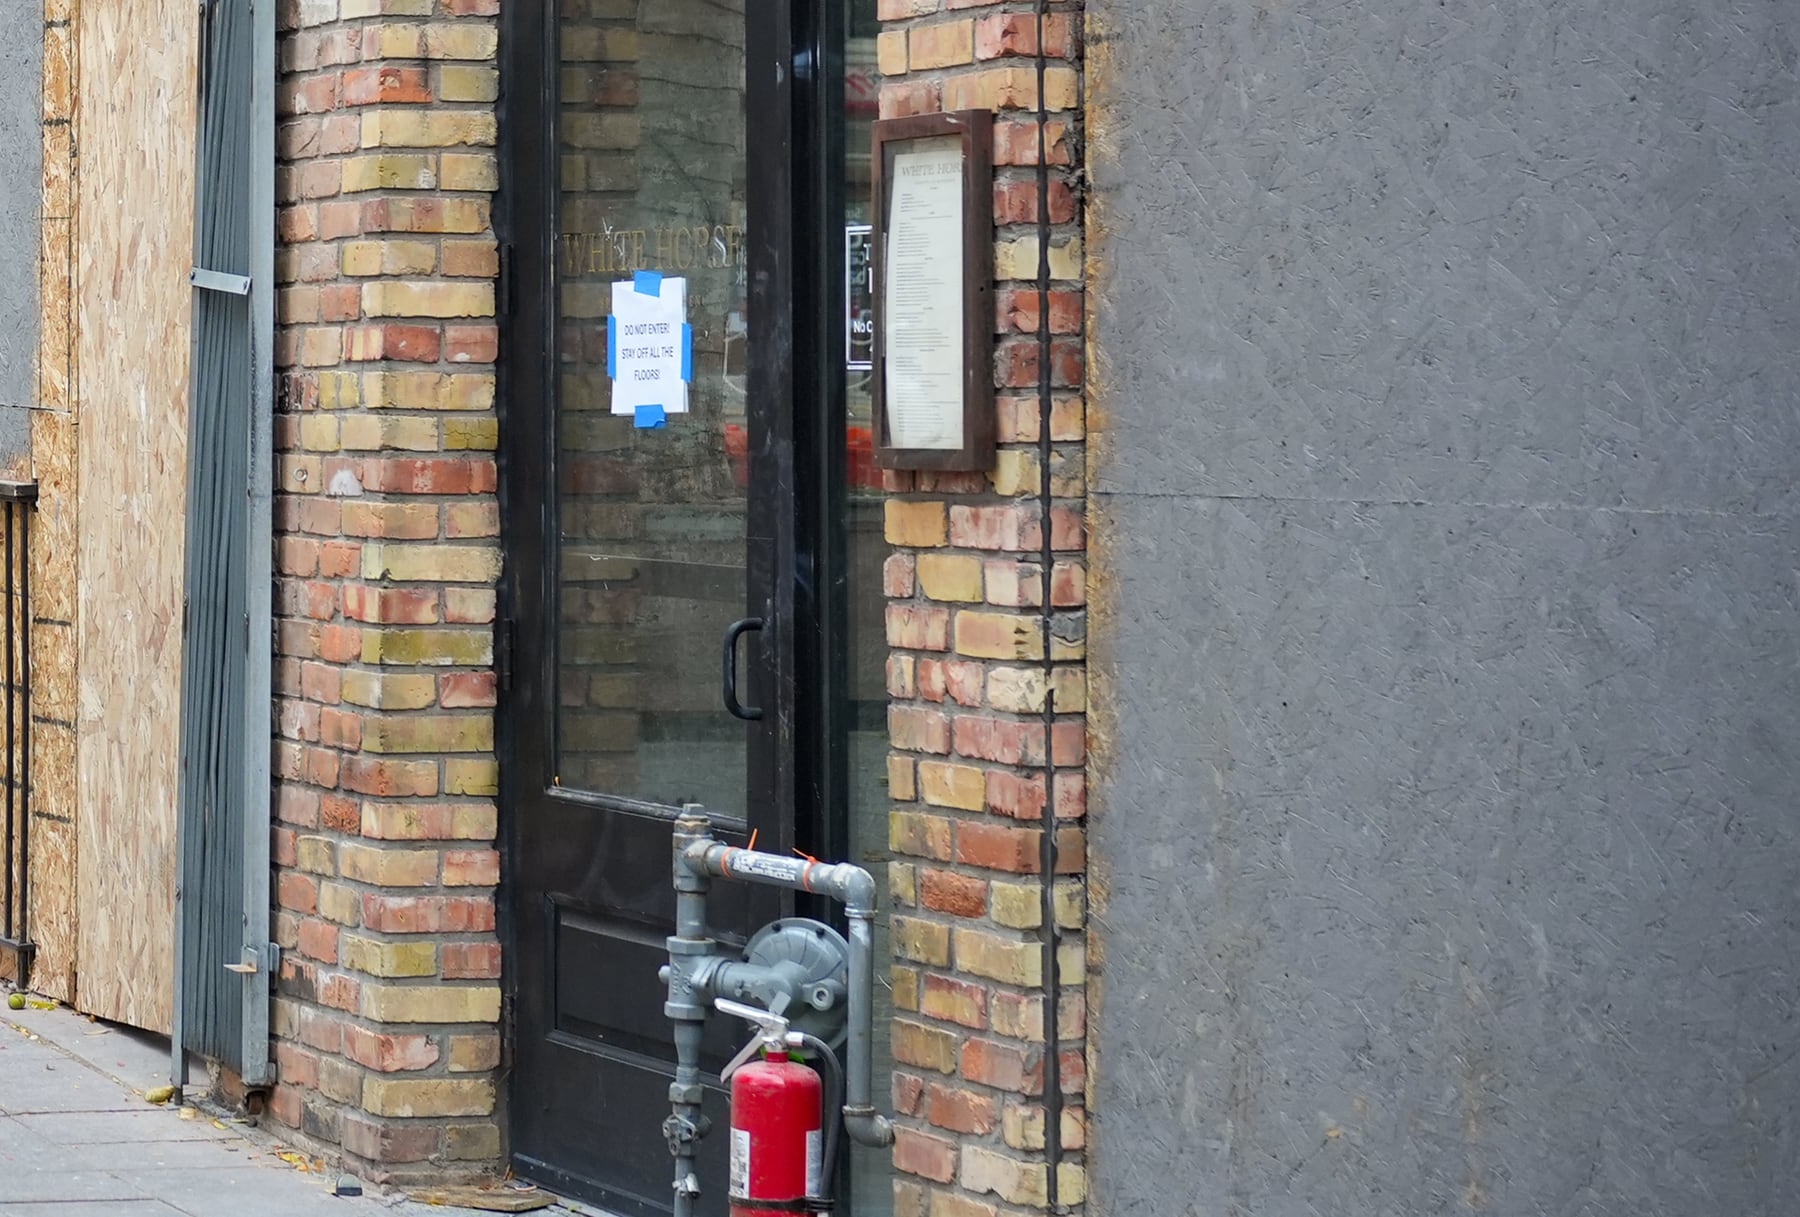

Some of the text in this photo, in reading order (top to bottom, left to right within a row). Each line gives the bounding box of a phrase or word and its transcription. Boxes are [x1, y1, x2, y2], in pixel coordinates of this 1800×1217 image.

[563, 224, 743, 273] WHITE HORSE
[624, 322, 670, 335] DO NOT ENTER!
[622, 346, 674, 359] STAY OFF ALL THE
[633, 369, 660, 381] FLOORS!
